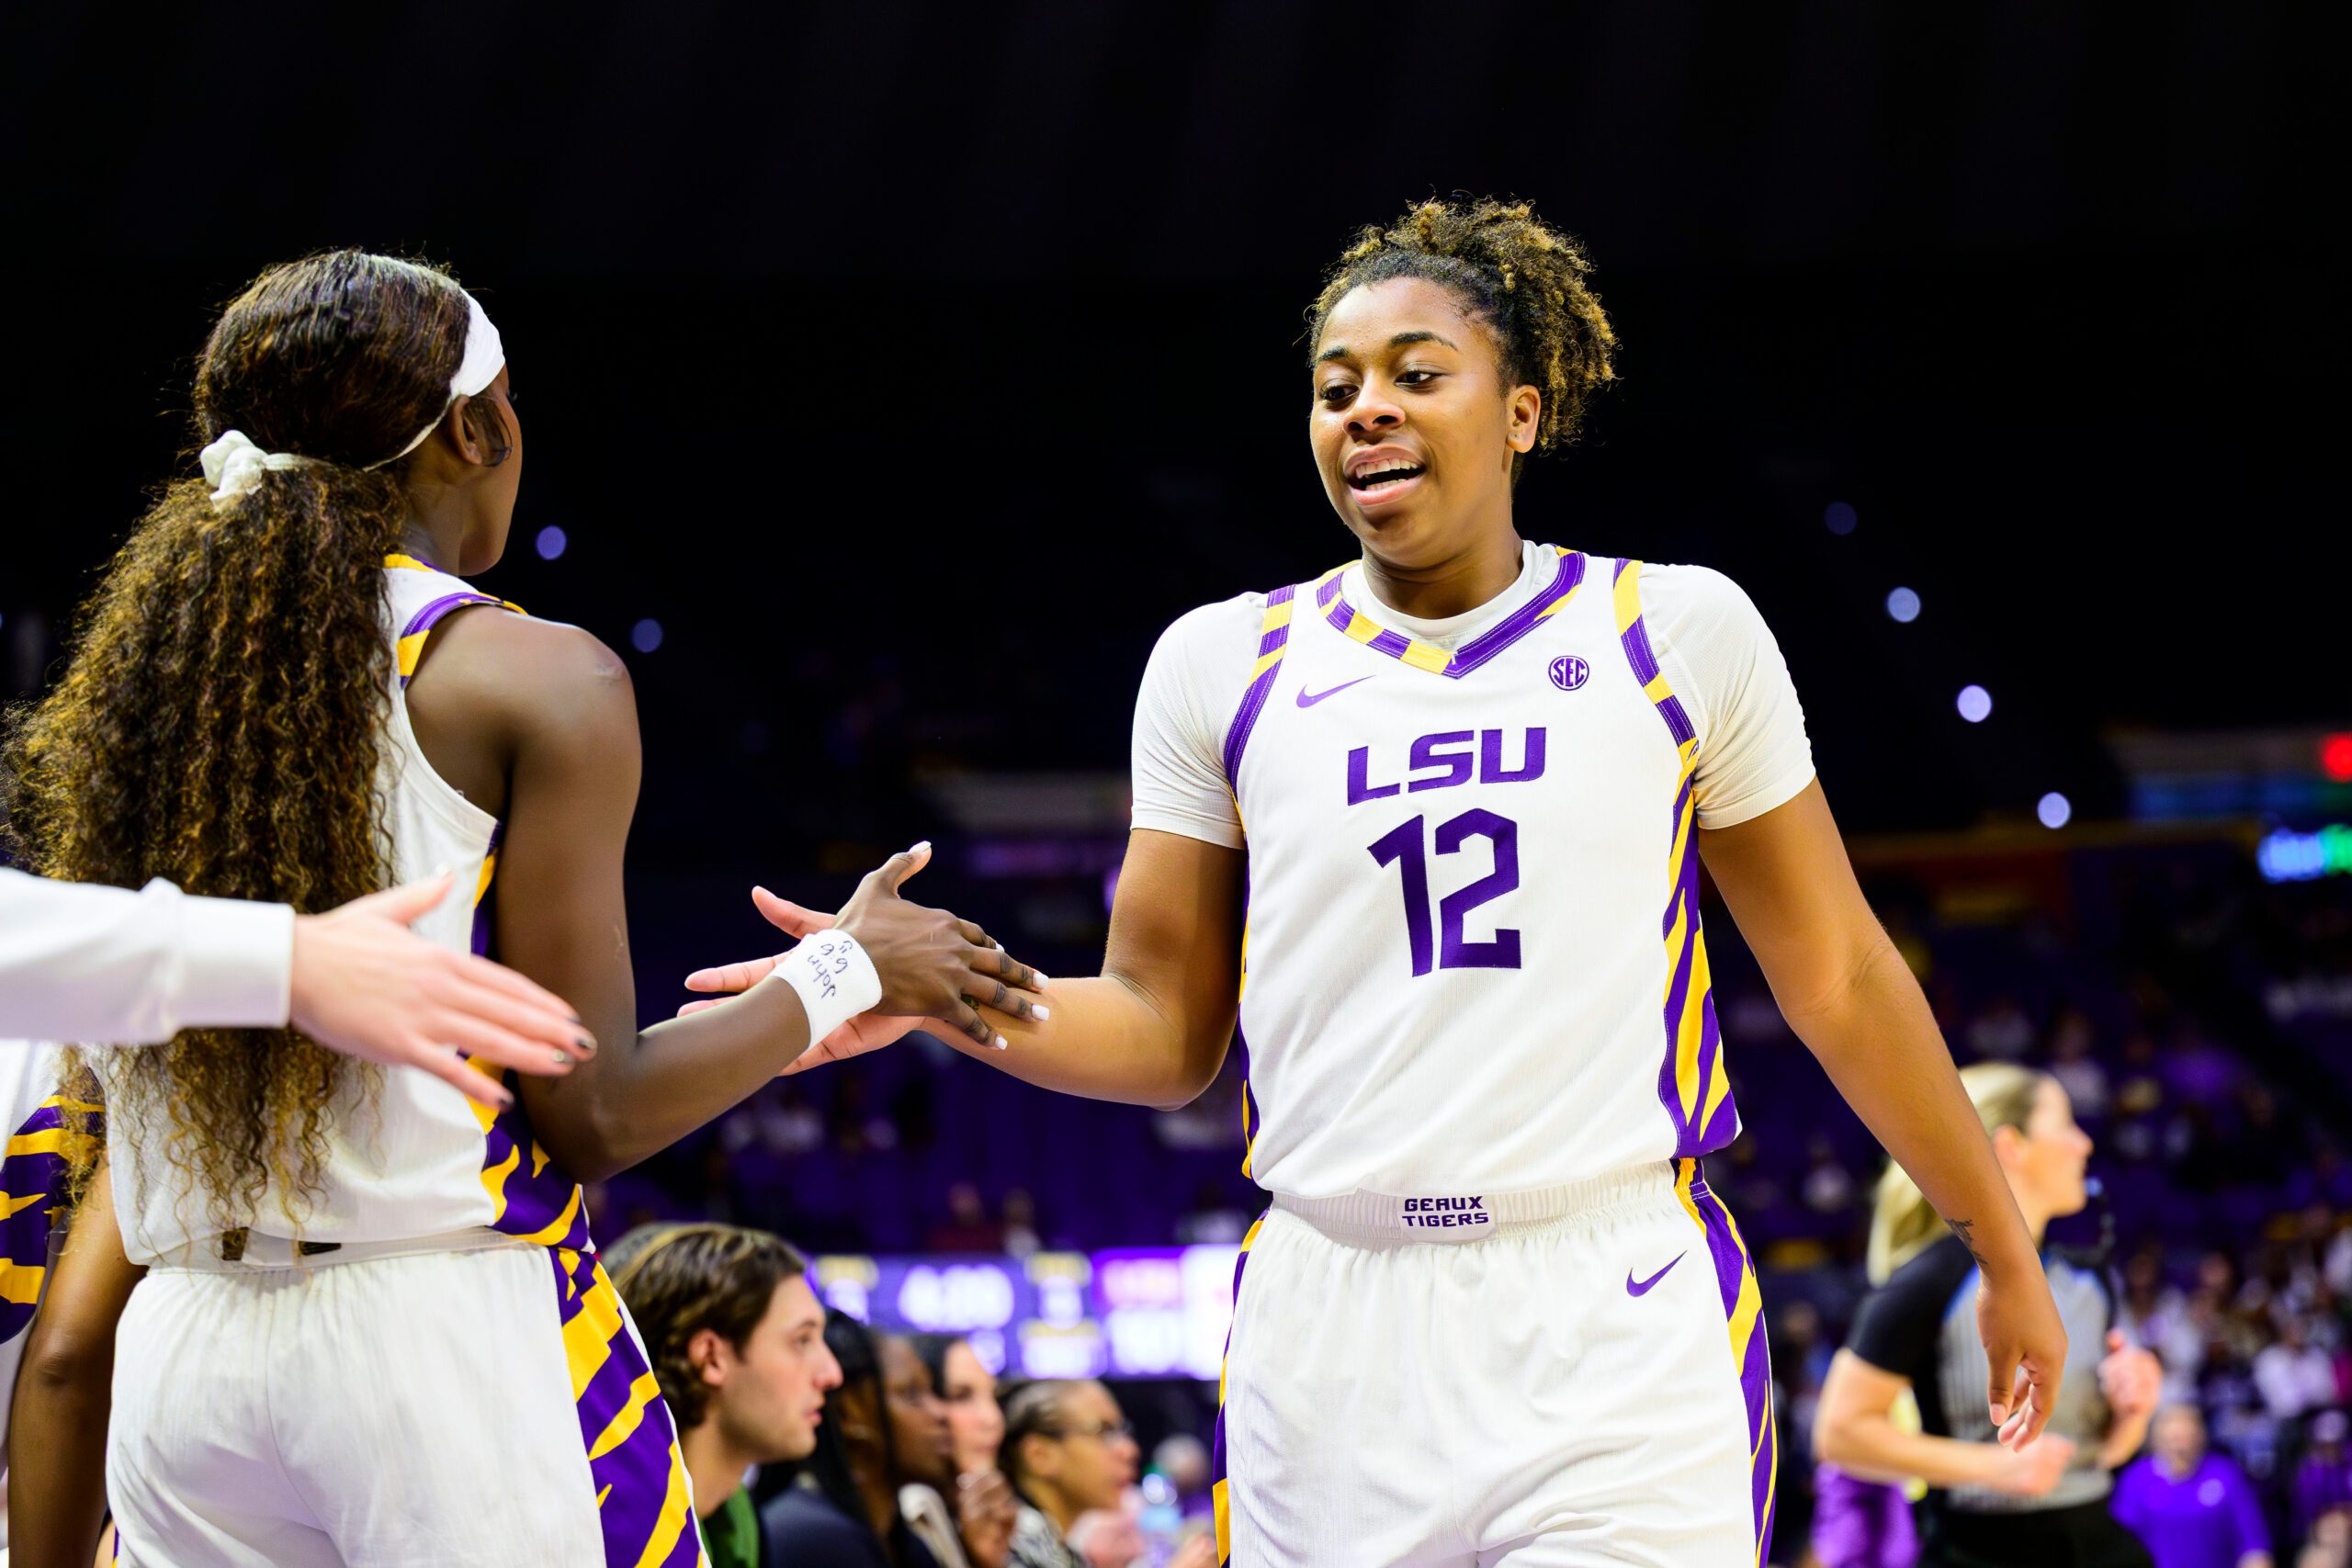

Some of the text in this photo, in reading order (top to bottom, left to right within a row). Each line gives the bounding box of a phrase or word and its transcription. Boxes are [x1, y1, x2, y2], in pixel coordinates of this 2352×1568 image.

[1553, 658, 1586, 687] SEC
[1347, 727, 1546, 807] LSU
[1366, 807, 1521, 977] 12
[808, 954, 836, 999] John
[1401, 1212, 1489, 1228] TIGERS
[1404, 1195, 1484, 1213] GEAUX
